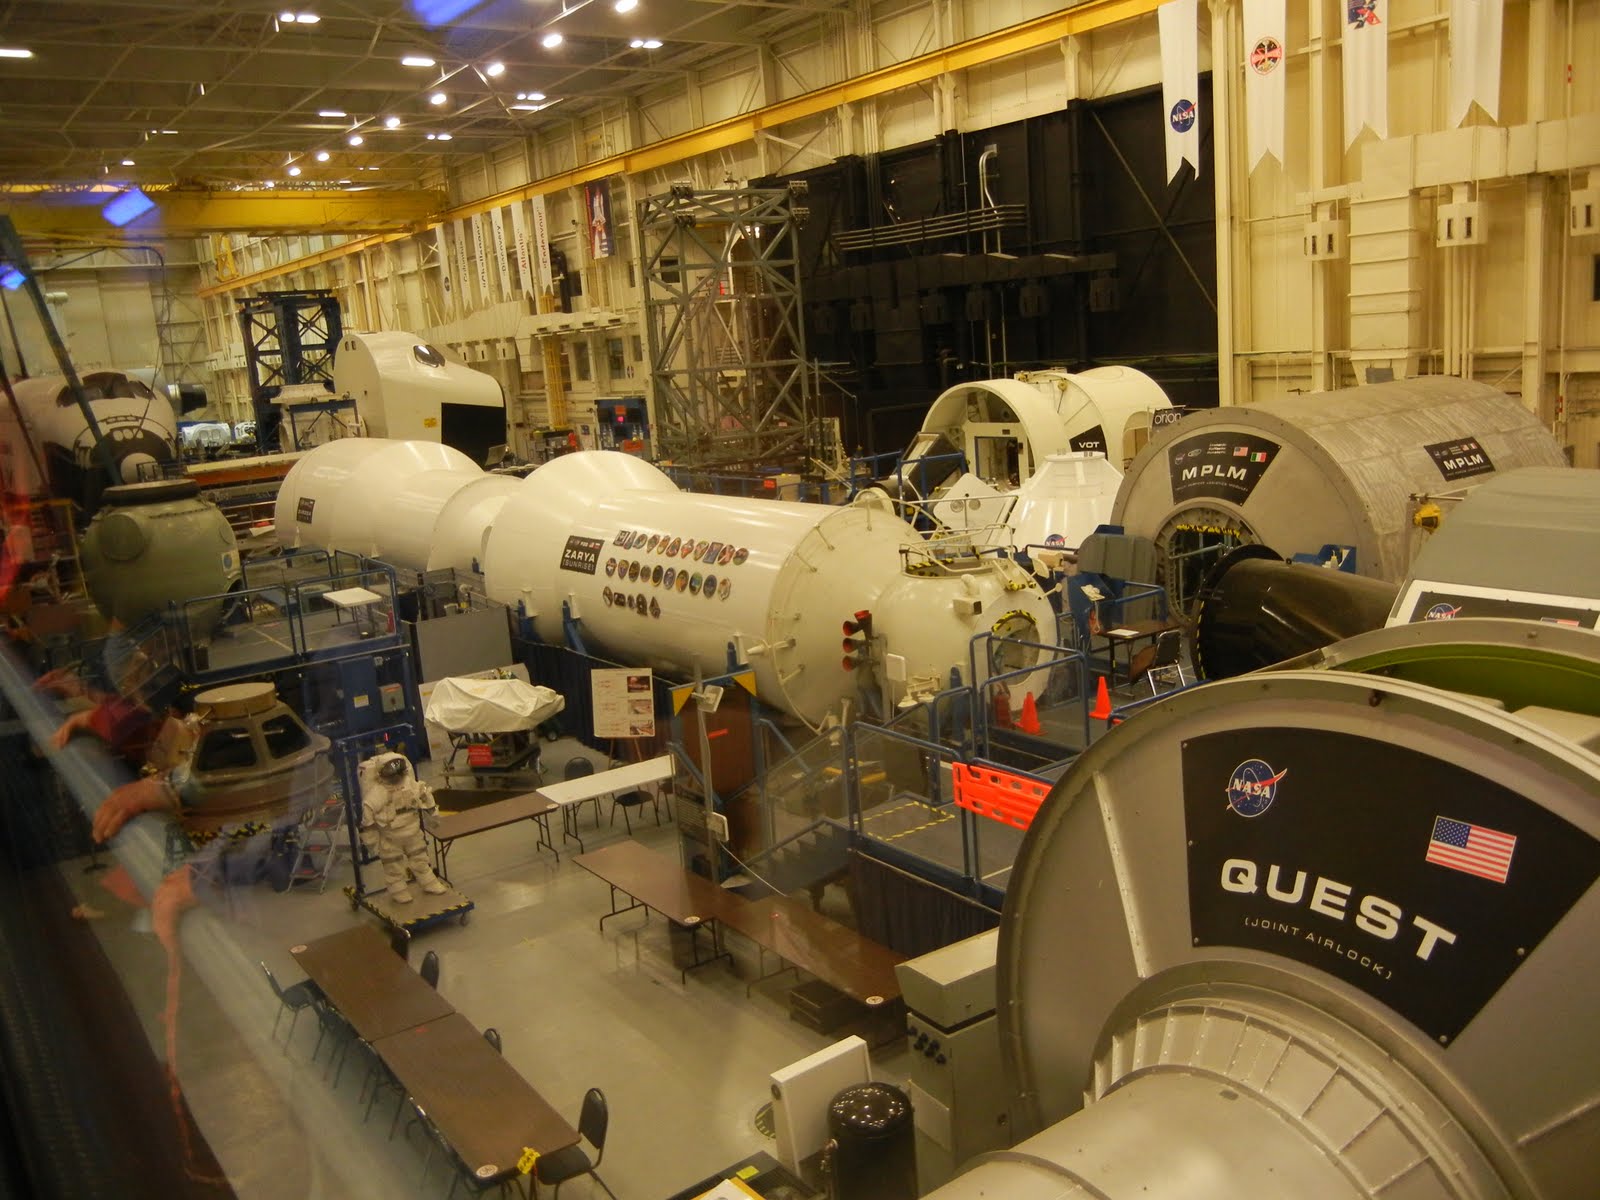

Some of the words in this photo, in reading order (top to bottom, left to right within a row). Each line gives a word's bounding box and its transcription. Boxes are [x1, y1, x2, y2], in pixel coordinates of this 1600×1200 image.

[1172, 111, 1194, 122] NASA
[1154, 411, 1182, 425] orion
[1079, 441, 1100, 449] VOT
[1443, 453, 1484, 471] MPLM
[1182, 464, 1247, 481] MPLM
[564, 549, 595, 562] ZARYA
[1428, 611, 1452, 620] NASA
[1232, 778, 1271, 799] NASA
[1221, 858, 1457, 961] QUEST
[1244, 917, 1300, 936] (JOINT
[1305, 932, 1393, 980] AIRLOCK)
